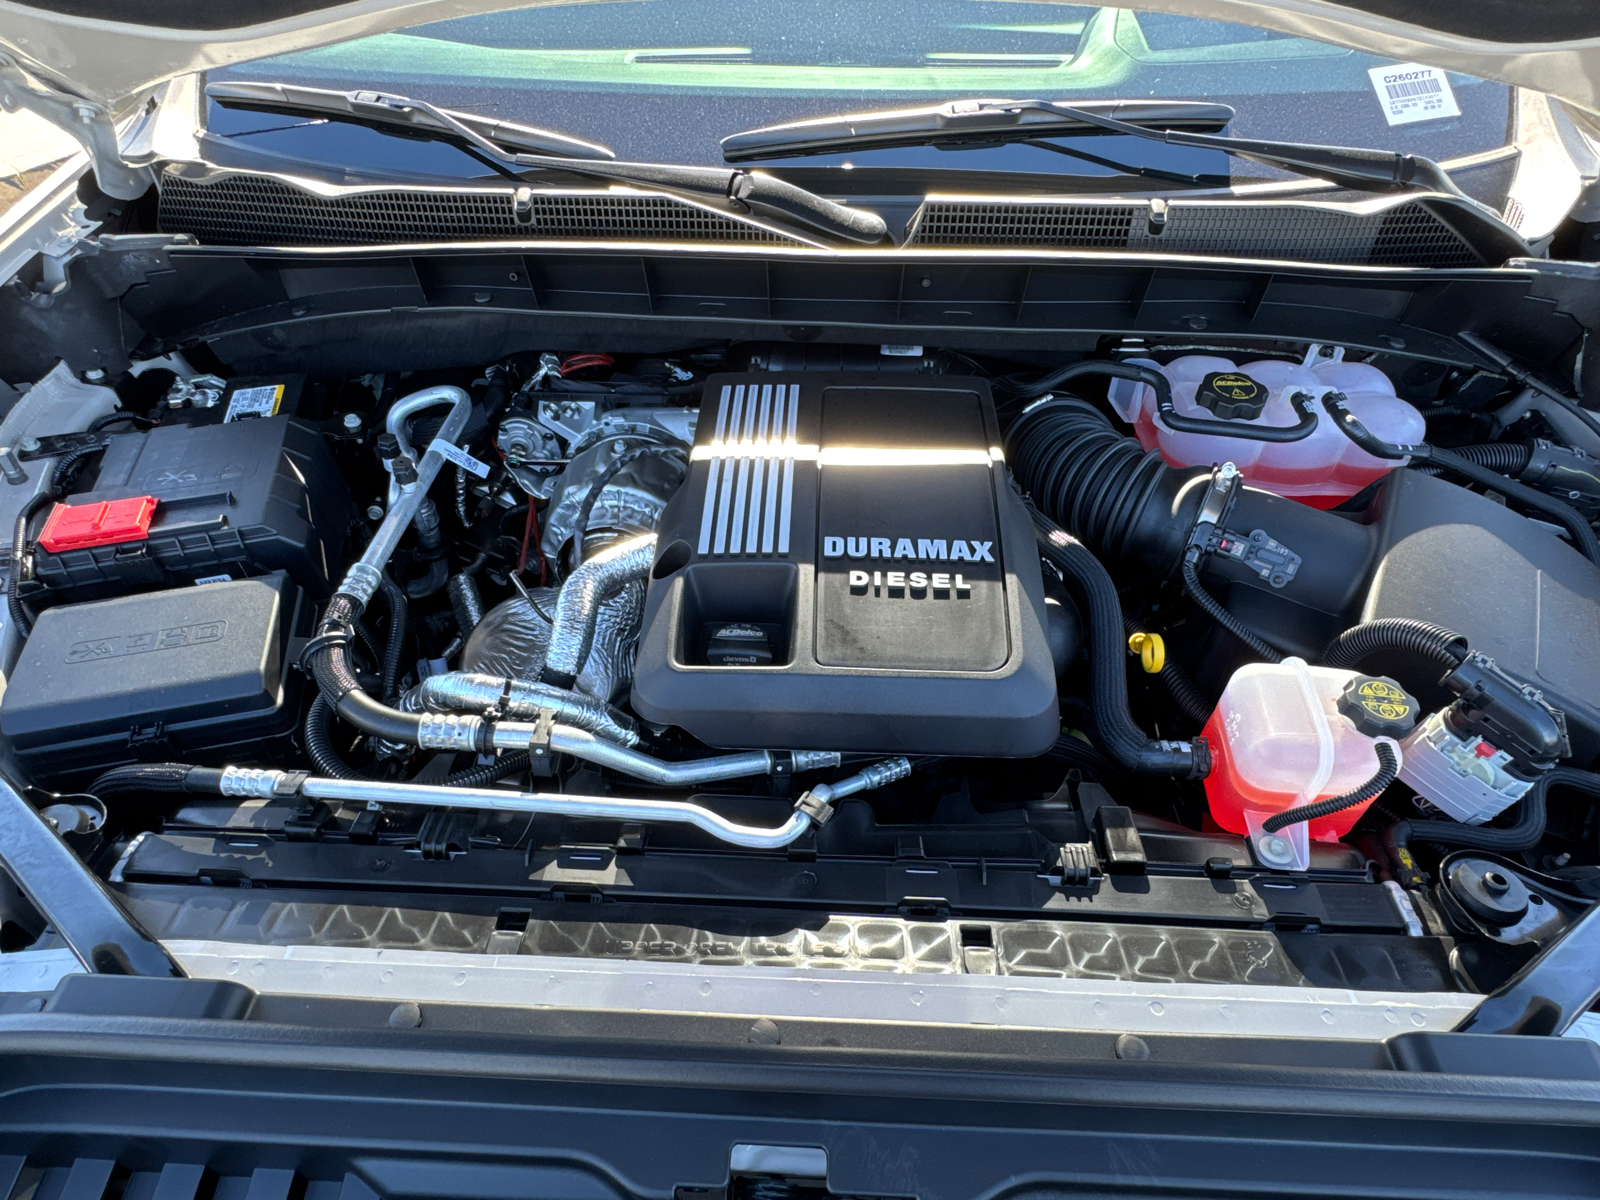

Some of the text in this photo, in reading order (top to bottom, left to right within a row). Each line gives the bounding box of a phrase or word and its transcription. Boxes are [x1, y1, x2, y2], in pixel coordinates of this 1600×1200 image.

[823, 536, 995, 563] DURAMAX
[850, 570, 971, 590] DIESEL
[716, 629, 763, 637] ACDelco
[604, 939, 676, 956] UPPER
